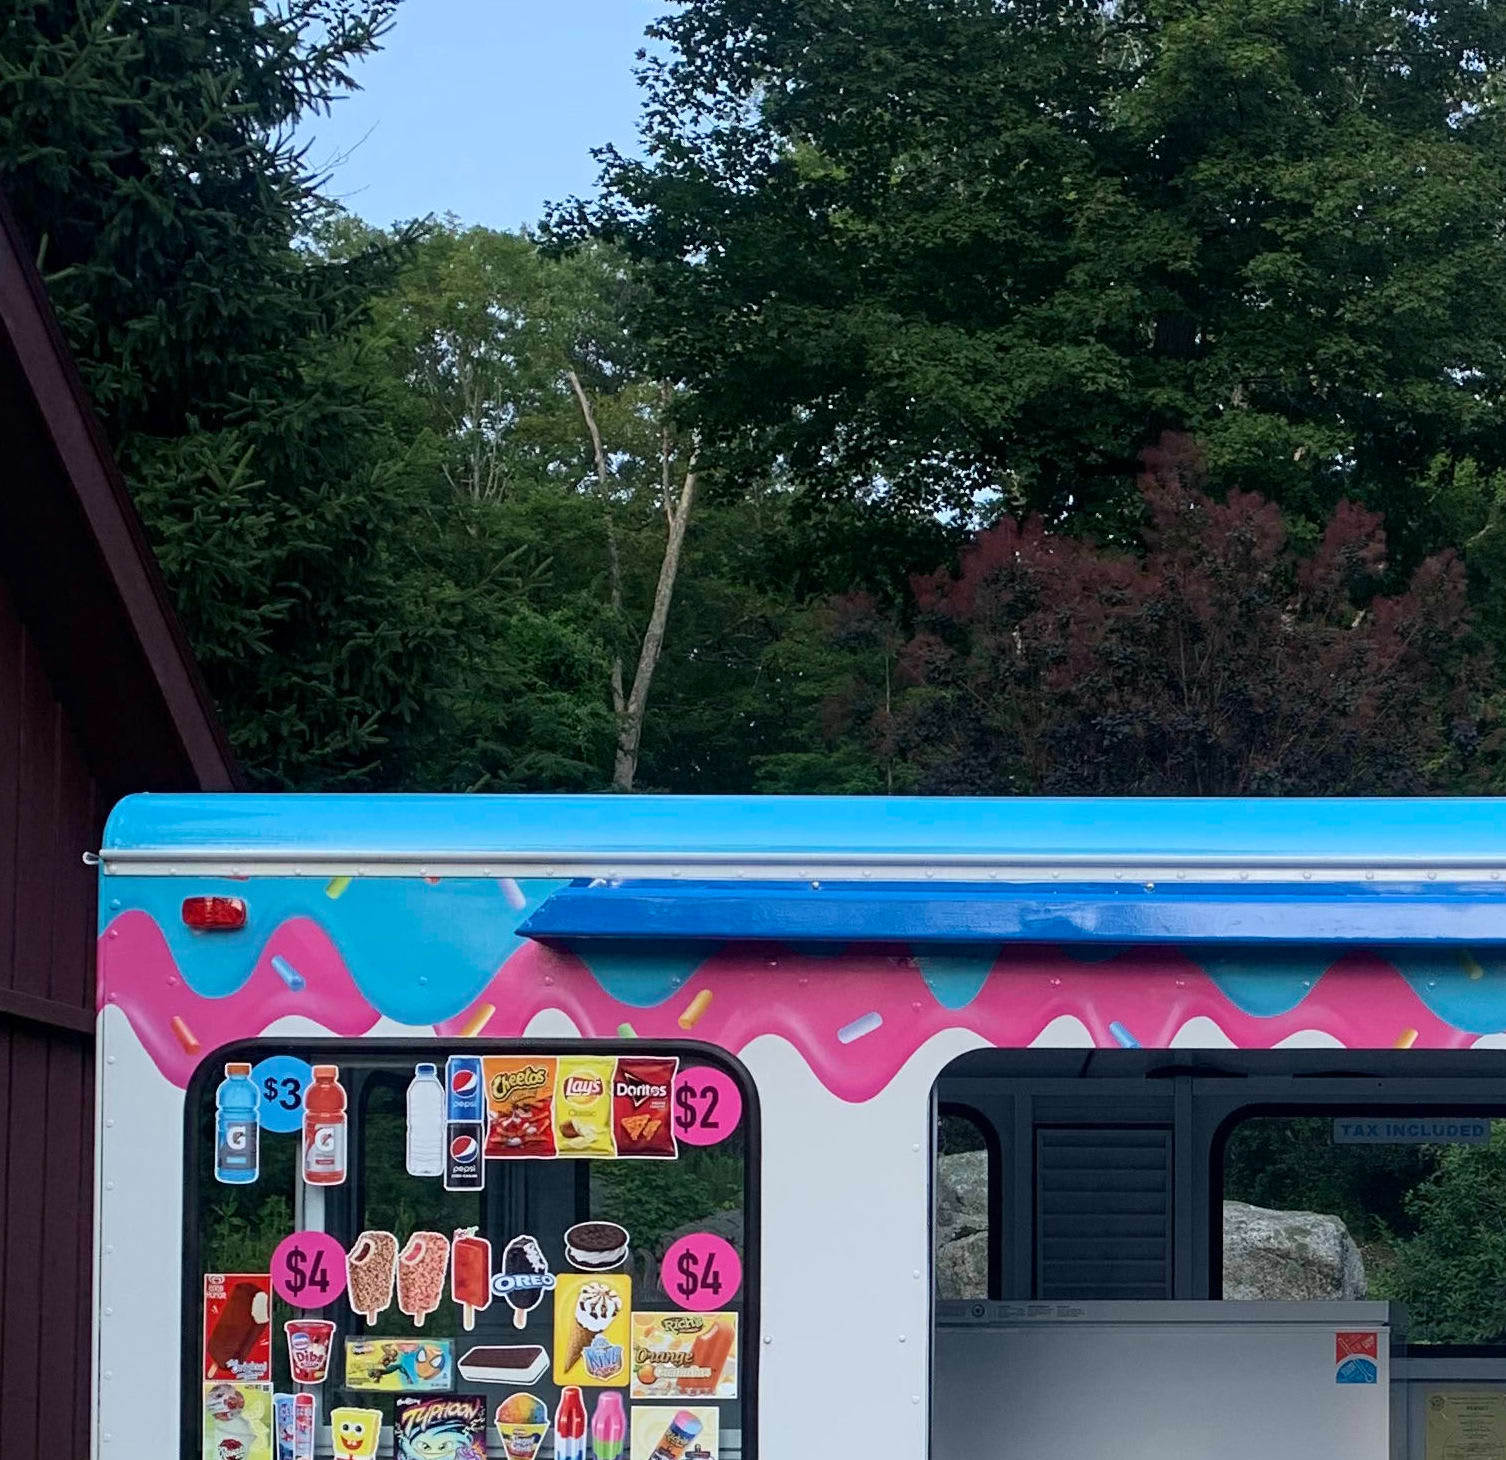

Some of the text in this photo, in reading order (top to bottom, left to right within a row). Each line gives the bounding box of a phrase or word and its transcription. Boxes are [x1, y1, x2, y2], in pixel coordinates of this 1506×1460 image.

[263, 1077, 300, 1110] $3
[491, 1066, 548, 1101] Cheetos
[616, 1083, 667, 1097] Doritos
[675, 1081, 719, 1133] $2
[226, 1126, 246, 1149] G
[314, 1126, 334, 1150] G
[1341, 1124, 1484, 1137] TAX INCLUDED
[452, 1166, 476, 1174] pepsi
[285, 1245, 329, 1297] $4
[494, 1275, 554, 1291] OREO
[677, 1248, 722, 1300] $4
[637, 1348, 695, 1367] Orange
[402, 1402, 478, 1437] TYPHOON
